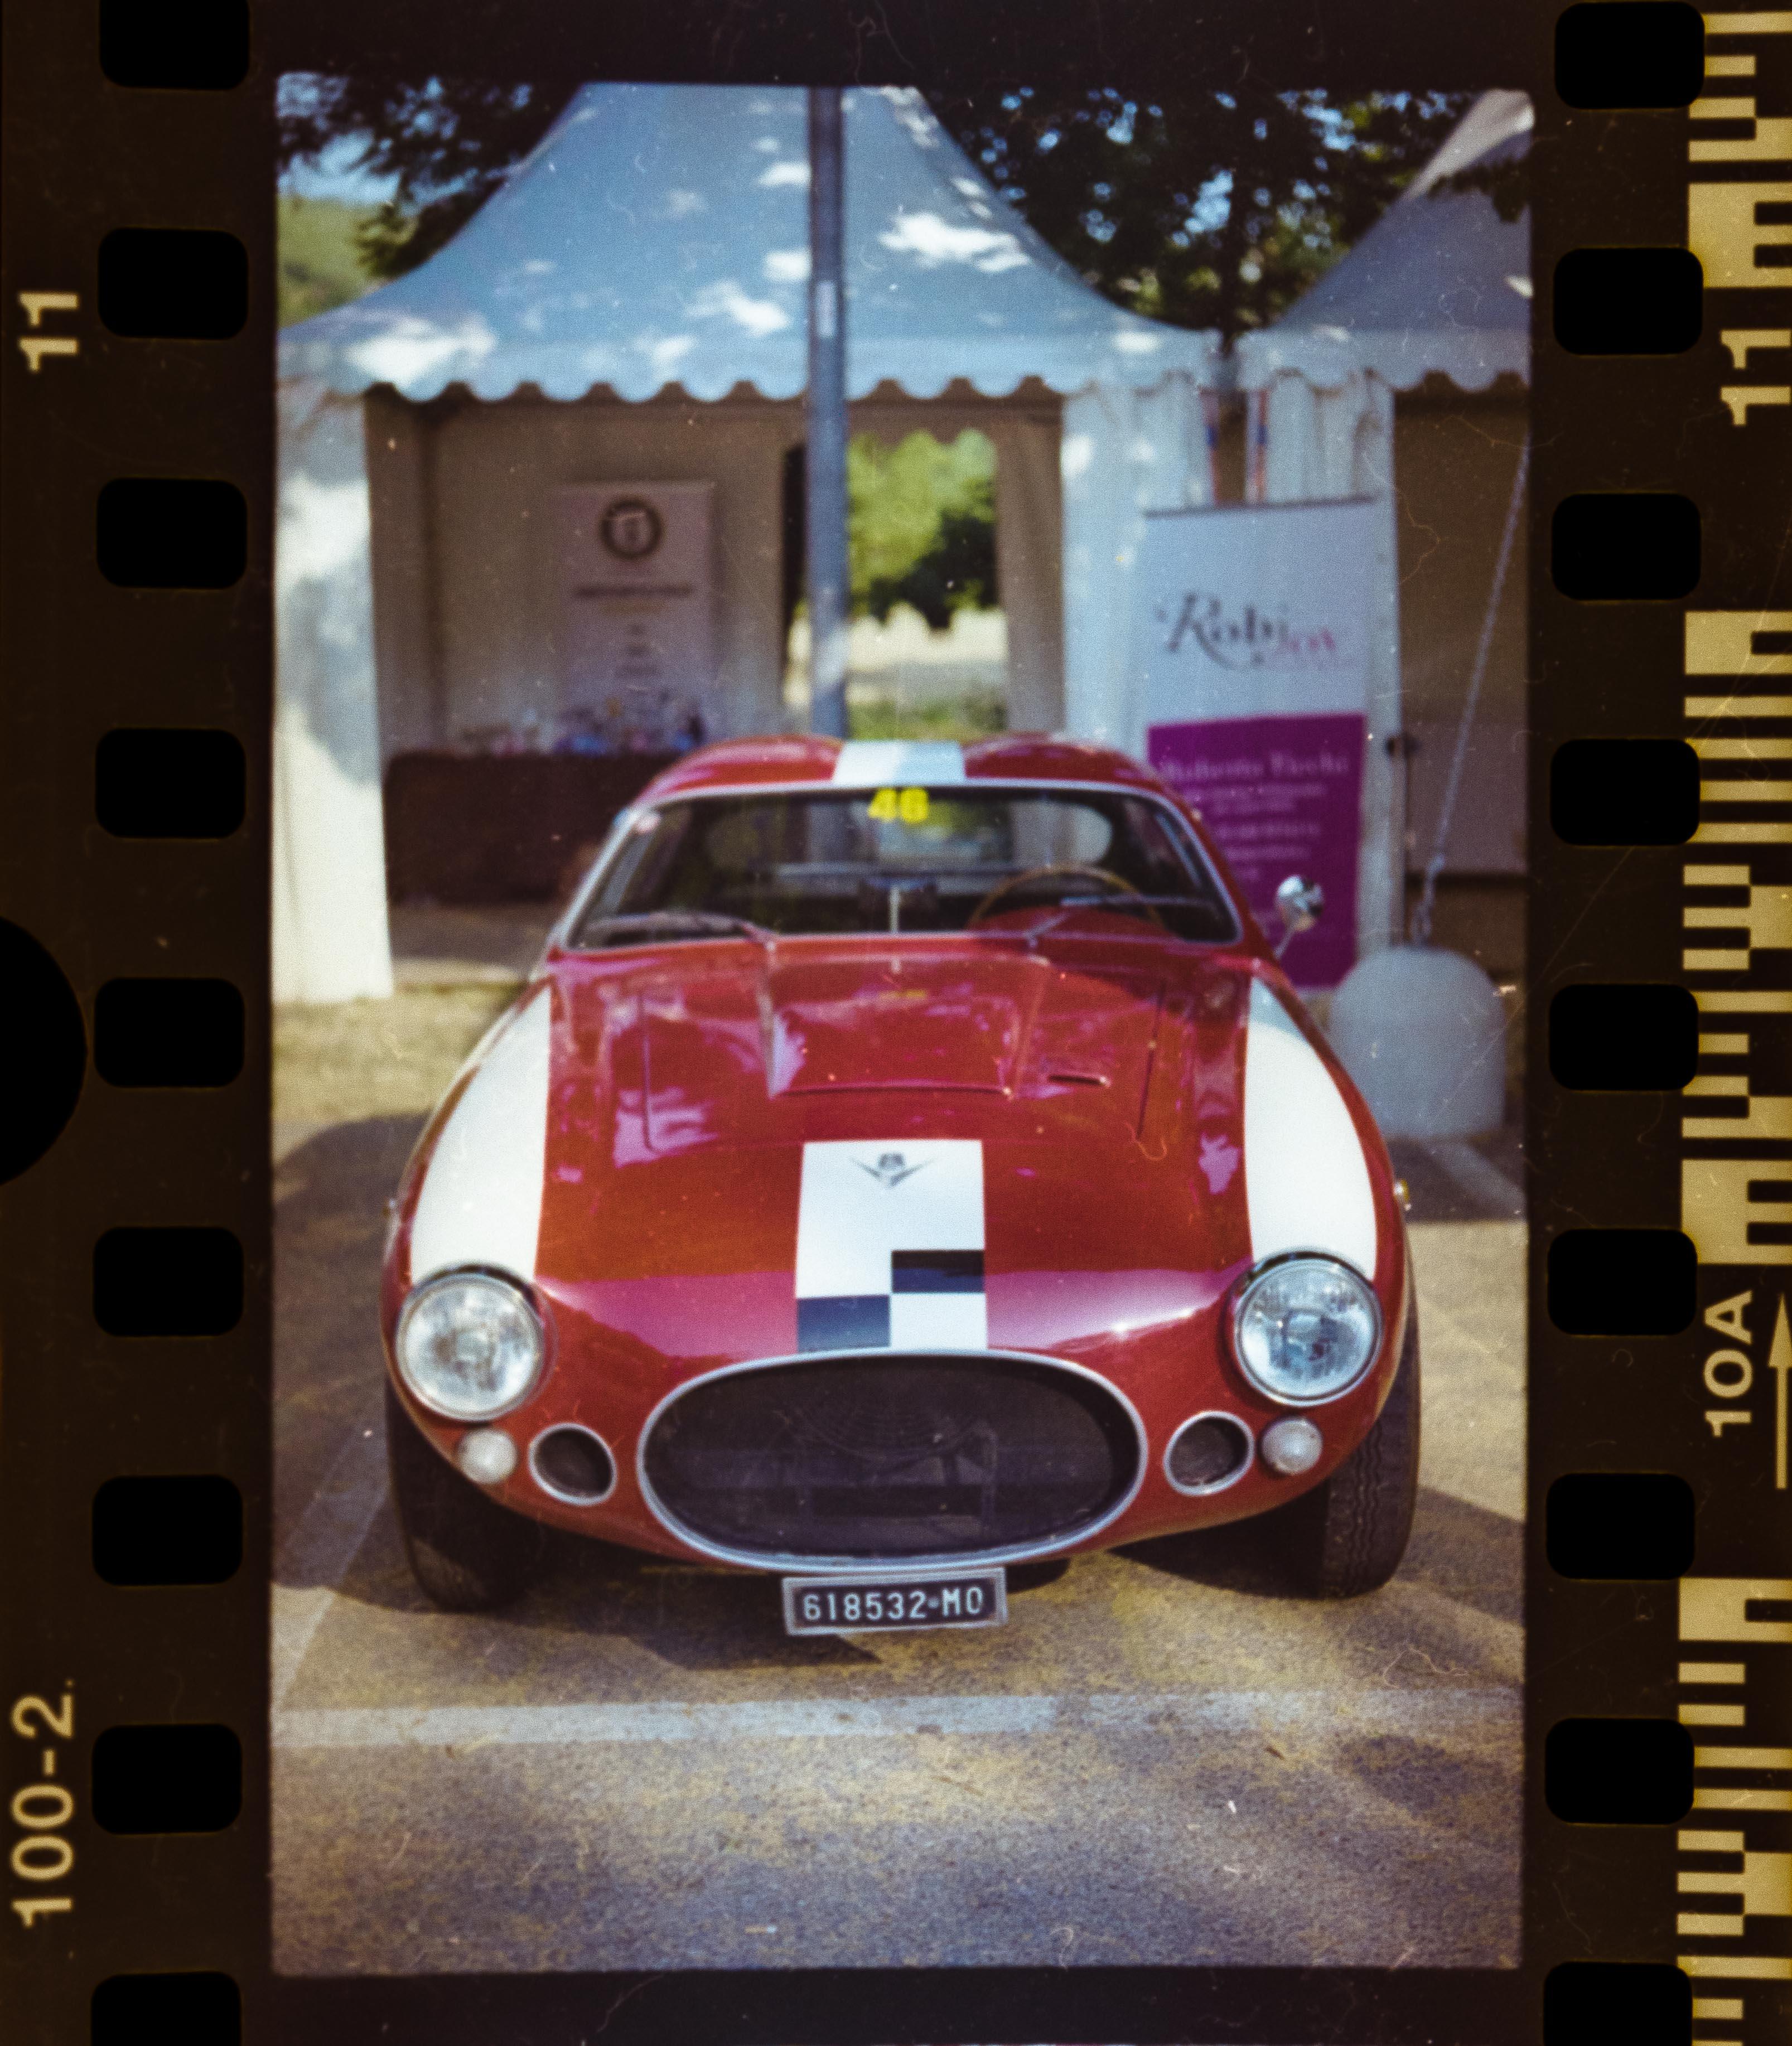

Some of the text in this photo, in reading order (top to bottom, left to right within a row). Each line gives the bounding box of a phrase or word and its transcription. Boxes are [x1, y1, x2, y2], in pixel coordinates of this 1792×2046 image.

[18, 291, 79, 373] 11
[1720, 329, 1791, 427] 11
[1704, 1289, 1753, 1437] 10A
